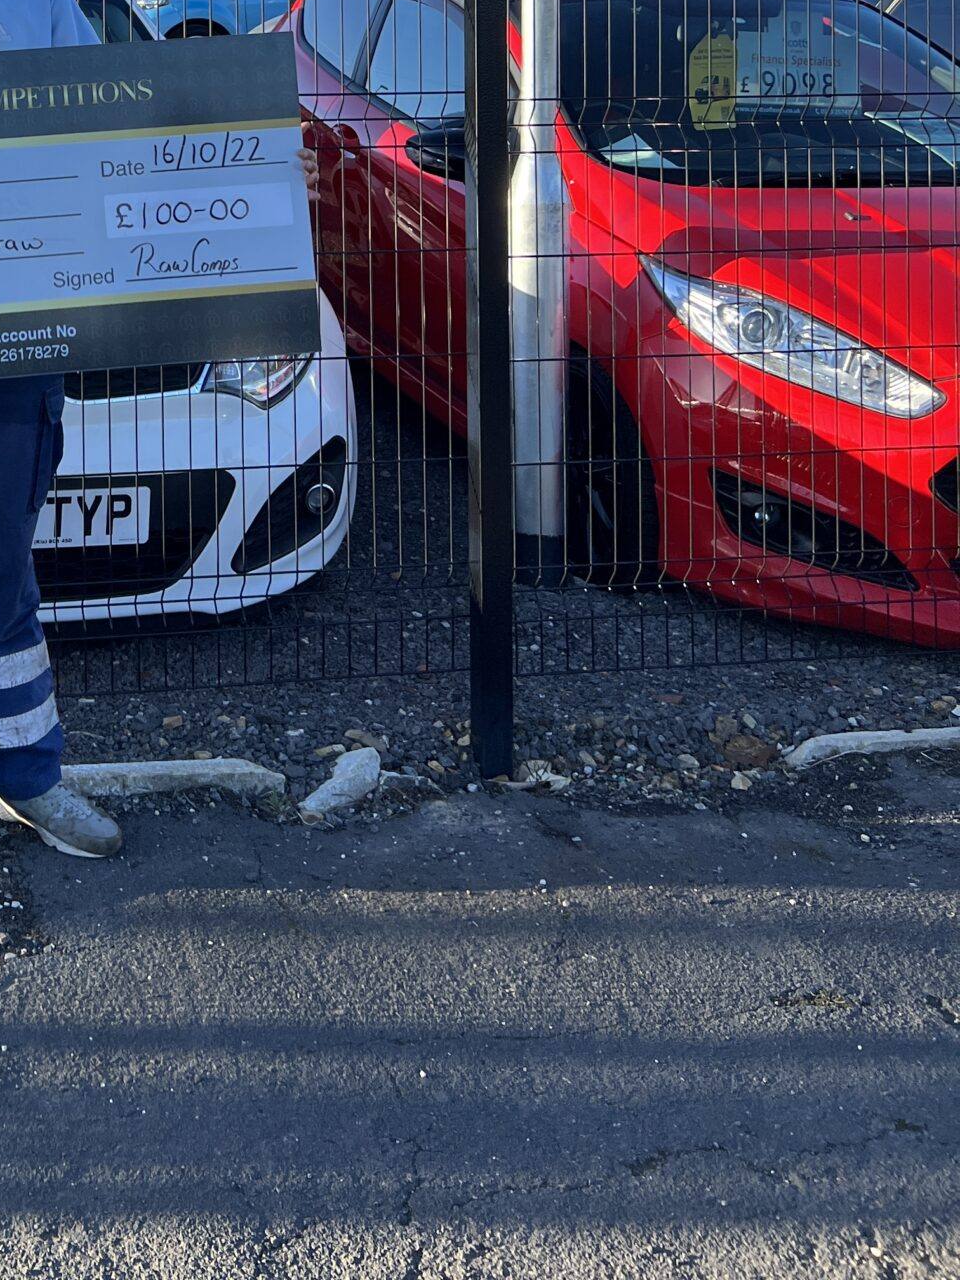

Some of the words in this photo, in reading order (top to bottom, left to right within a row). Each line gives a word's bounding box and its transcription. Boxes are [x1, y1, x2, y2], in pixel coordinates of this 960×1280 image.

[751, 53, 788, 65] Fnanc
[153, 131, 266, 170] 16/10/22
[100, 159, 145, 178] Date
[115, 198, 250, 230] £100-00
[53, 268, 115, 290] Signed
[56, 323, 77, 339] No
[0, 344, 69, 363] 26178279
[46, 494, 132, 538] TYP
